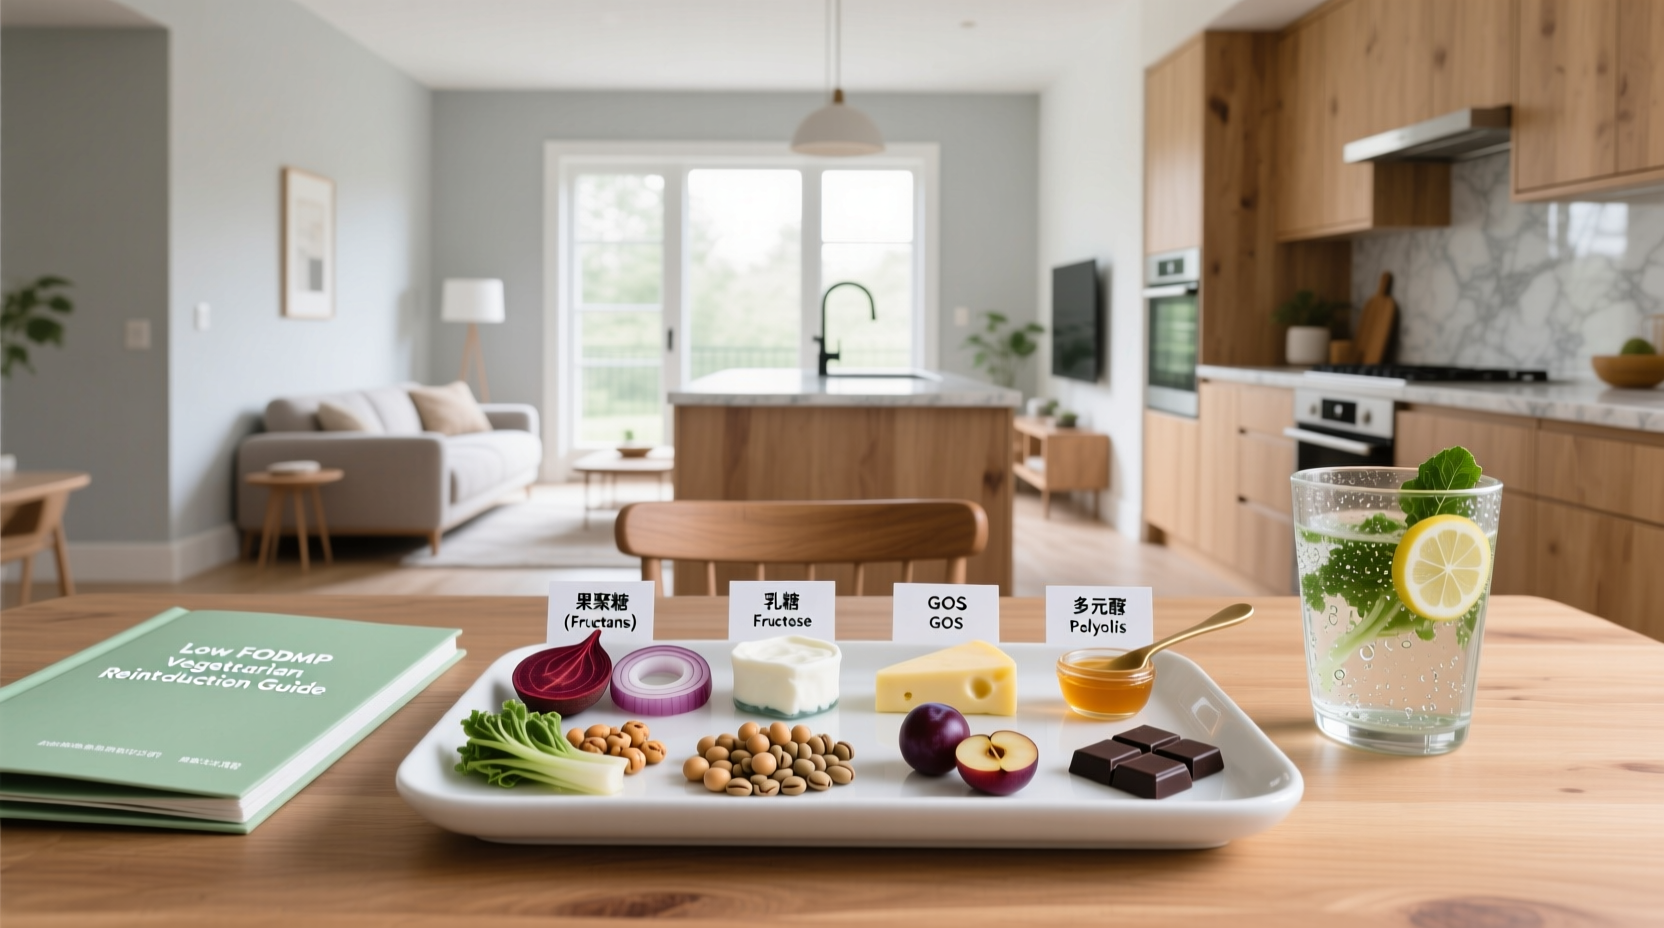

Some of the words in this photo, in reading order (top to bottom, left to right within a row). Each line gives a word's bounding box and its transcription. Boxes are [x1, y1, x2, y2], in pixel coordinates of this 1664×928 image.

[928, 595, 968, 611] GOS
[564, 613, 637, 632] (Fructans)
[753, 613, 812, 628] Fructose
[929, 616, 964, 630] GOS
[179, 642, 235, 658] Low
[236, 646, 334, 666] FODMP
[257, 678, 327, 696] Guide
